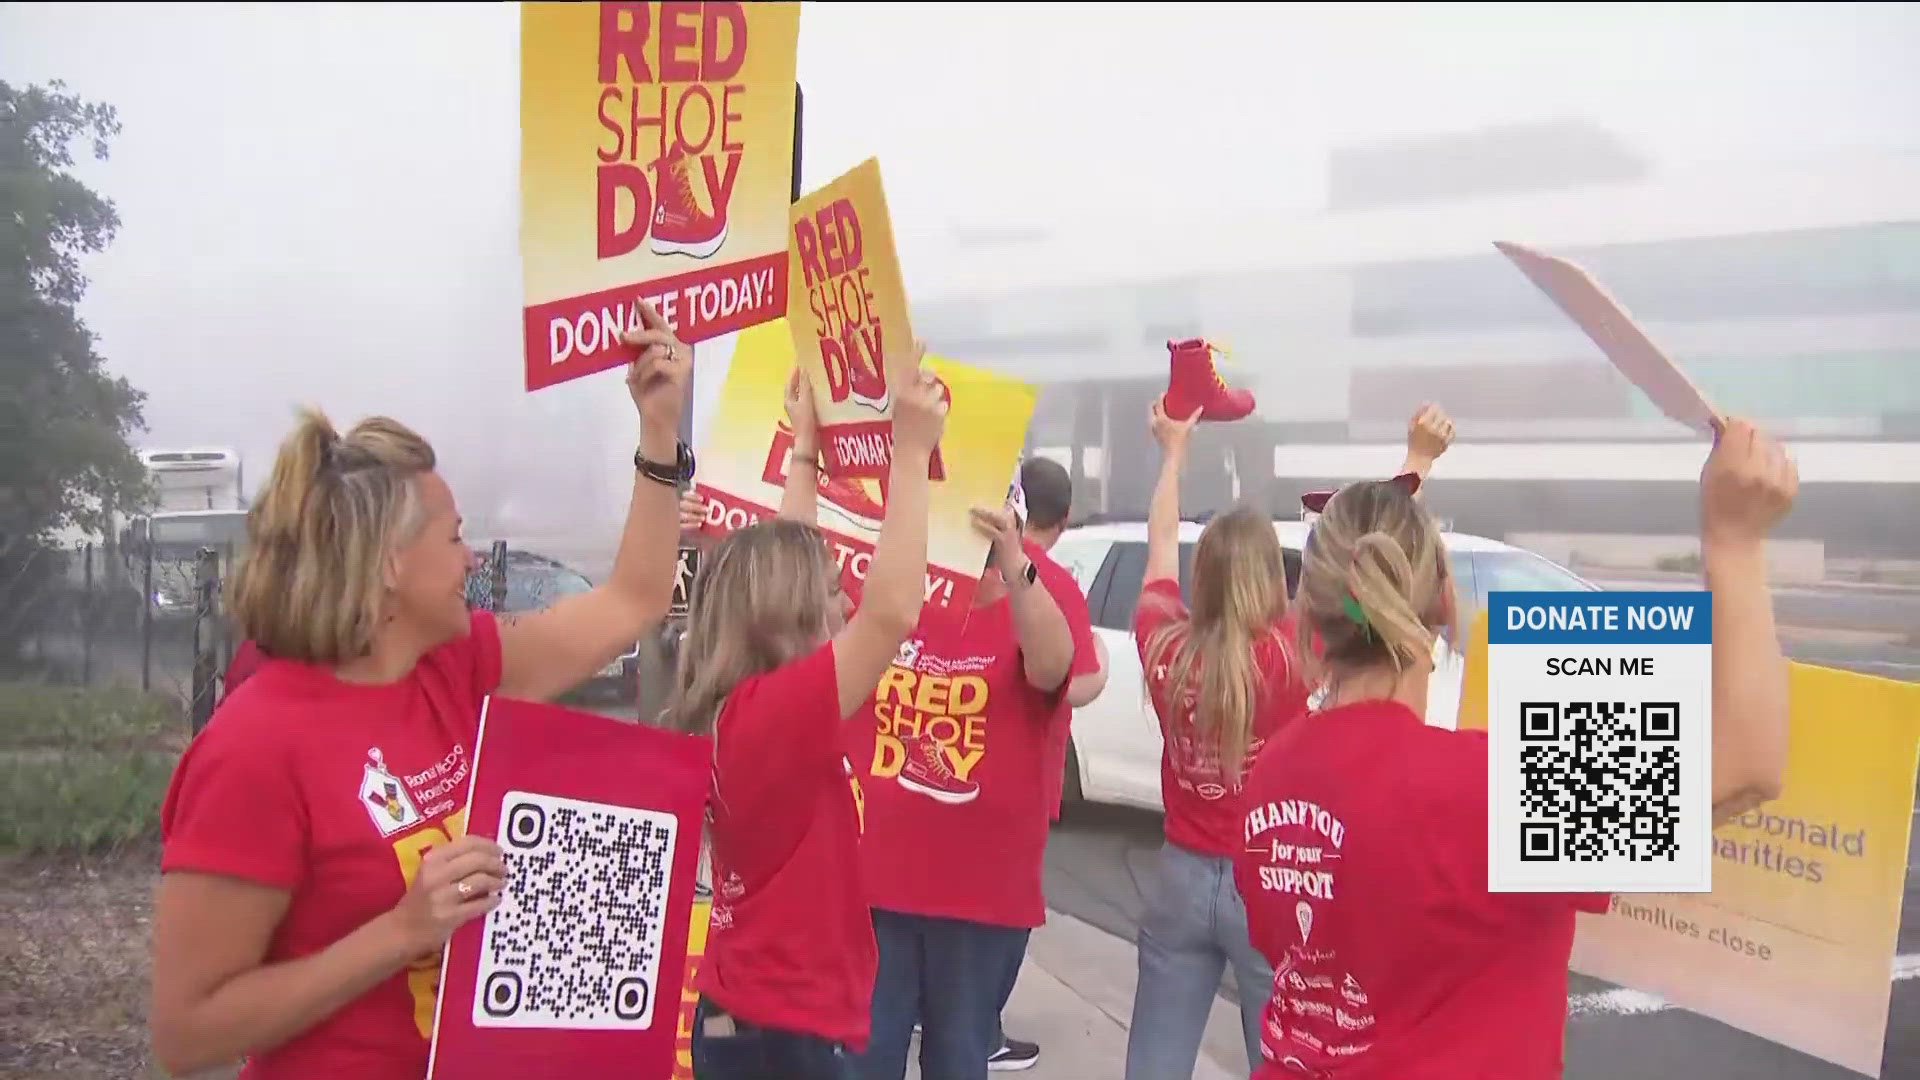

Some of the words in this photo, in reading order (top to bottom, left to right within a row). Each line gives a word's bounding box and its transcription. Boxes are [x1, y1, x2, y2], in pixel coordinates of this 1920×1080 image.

[598, 2, 748, 83] RED
[597, 84, 746, 163] SHOE
[597, 151, 742, 260] DY
[795, 198, 863, 288] RED
[685, 266, 774, 327] TODAY!
[810, 267, 880, 338] SHOE
[820, 323, 886, 403] DY
[876, 665, 988, 715] RED
[870, 733, 985, 783] DY
[874, 702, 987, 750] SHOE
[1271, 838, 1295, 863] for
[1295, 846, 1323, 866] your
[1708, 927, 1772, 960] close
